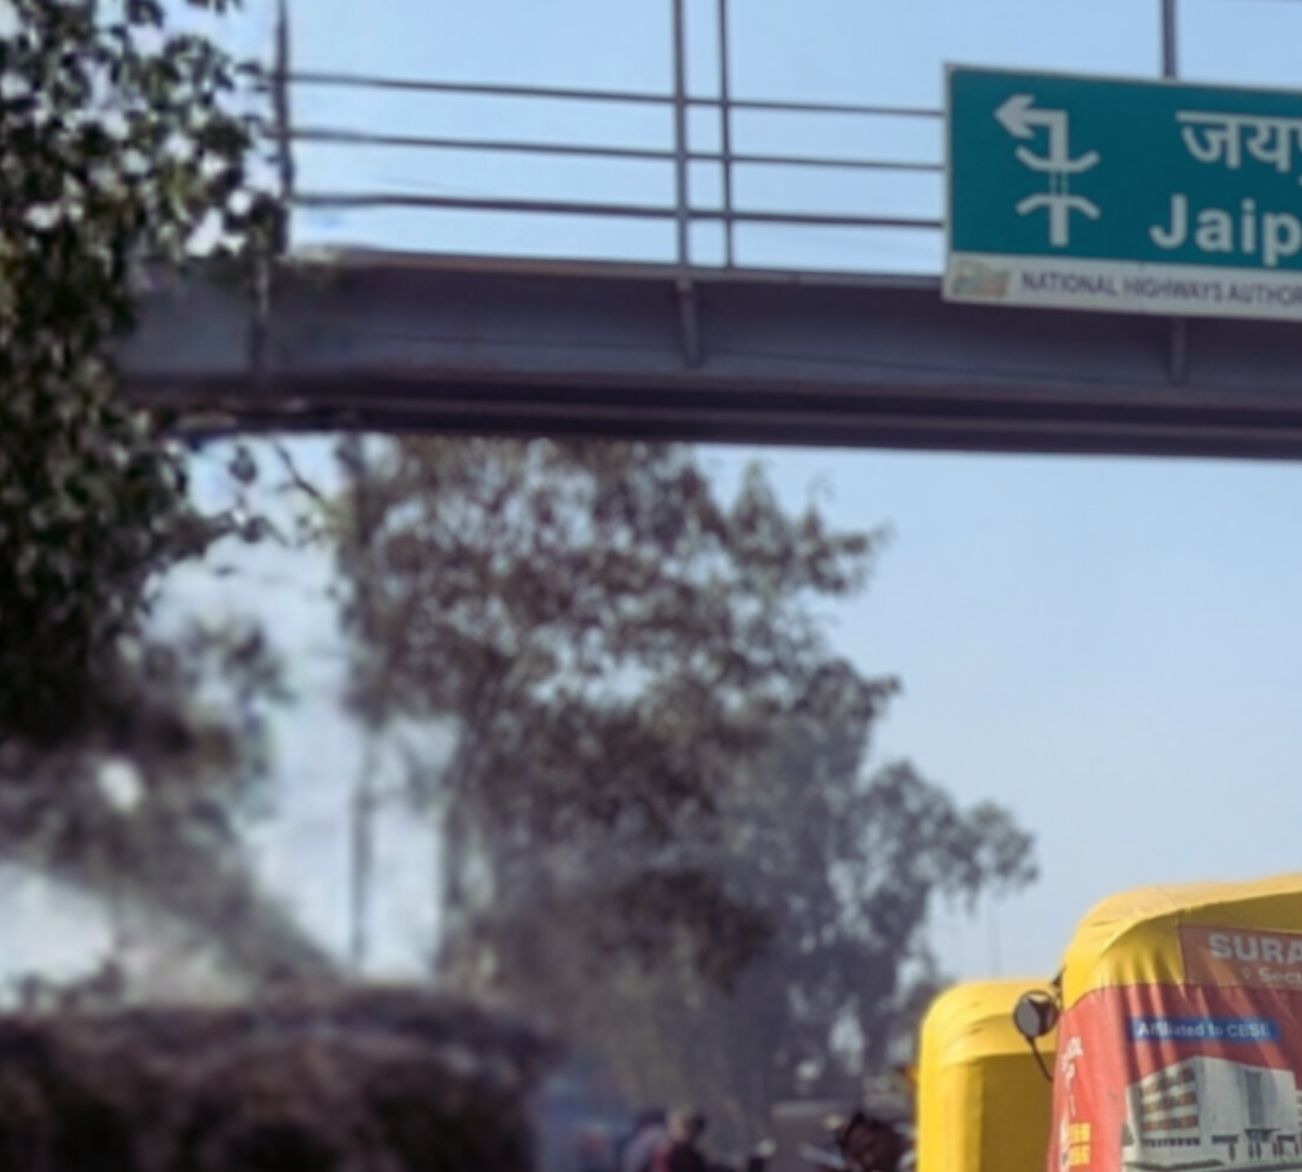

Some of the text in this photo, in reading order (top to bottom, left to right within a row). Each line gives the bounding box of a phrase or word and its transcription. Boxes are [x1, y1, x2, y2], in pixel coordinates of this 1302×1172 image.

[1021, 269, 1119, 298] NATIONAL
[1122, 276, 1223, 304] HIGHWAYS
[1137, 1020, 1206, 1038] Affiliated
[1207, 1021, 1224, 1038] to
